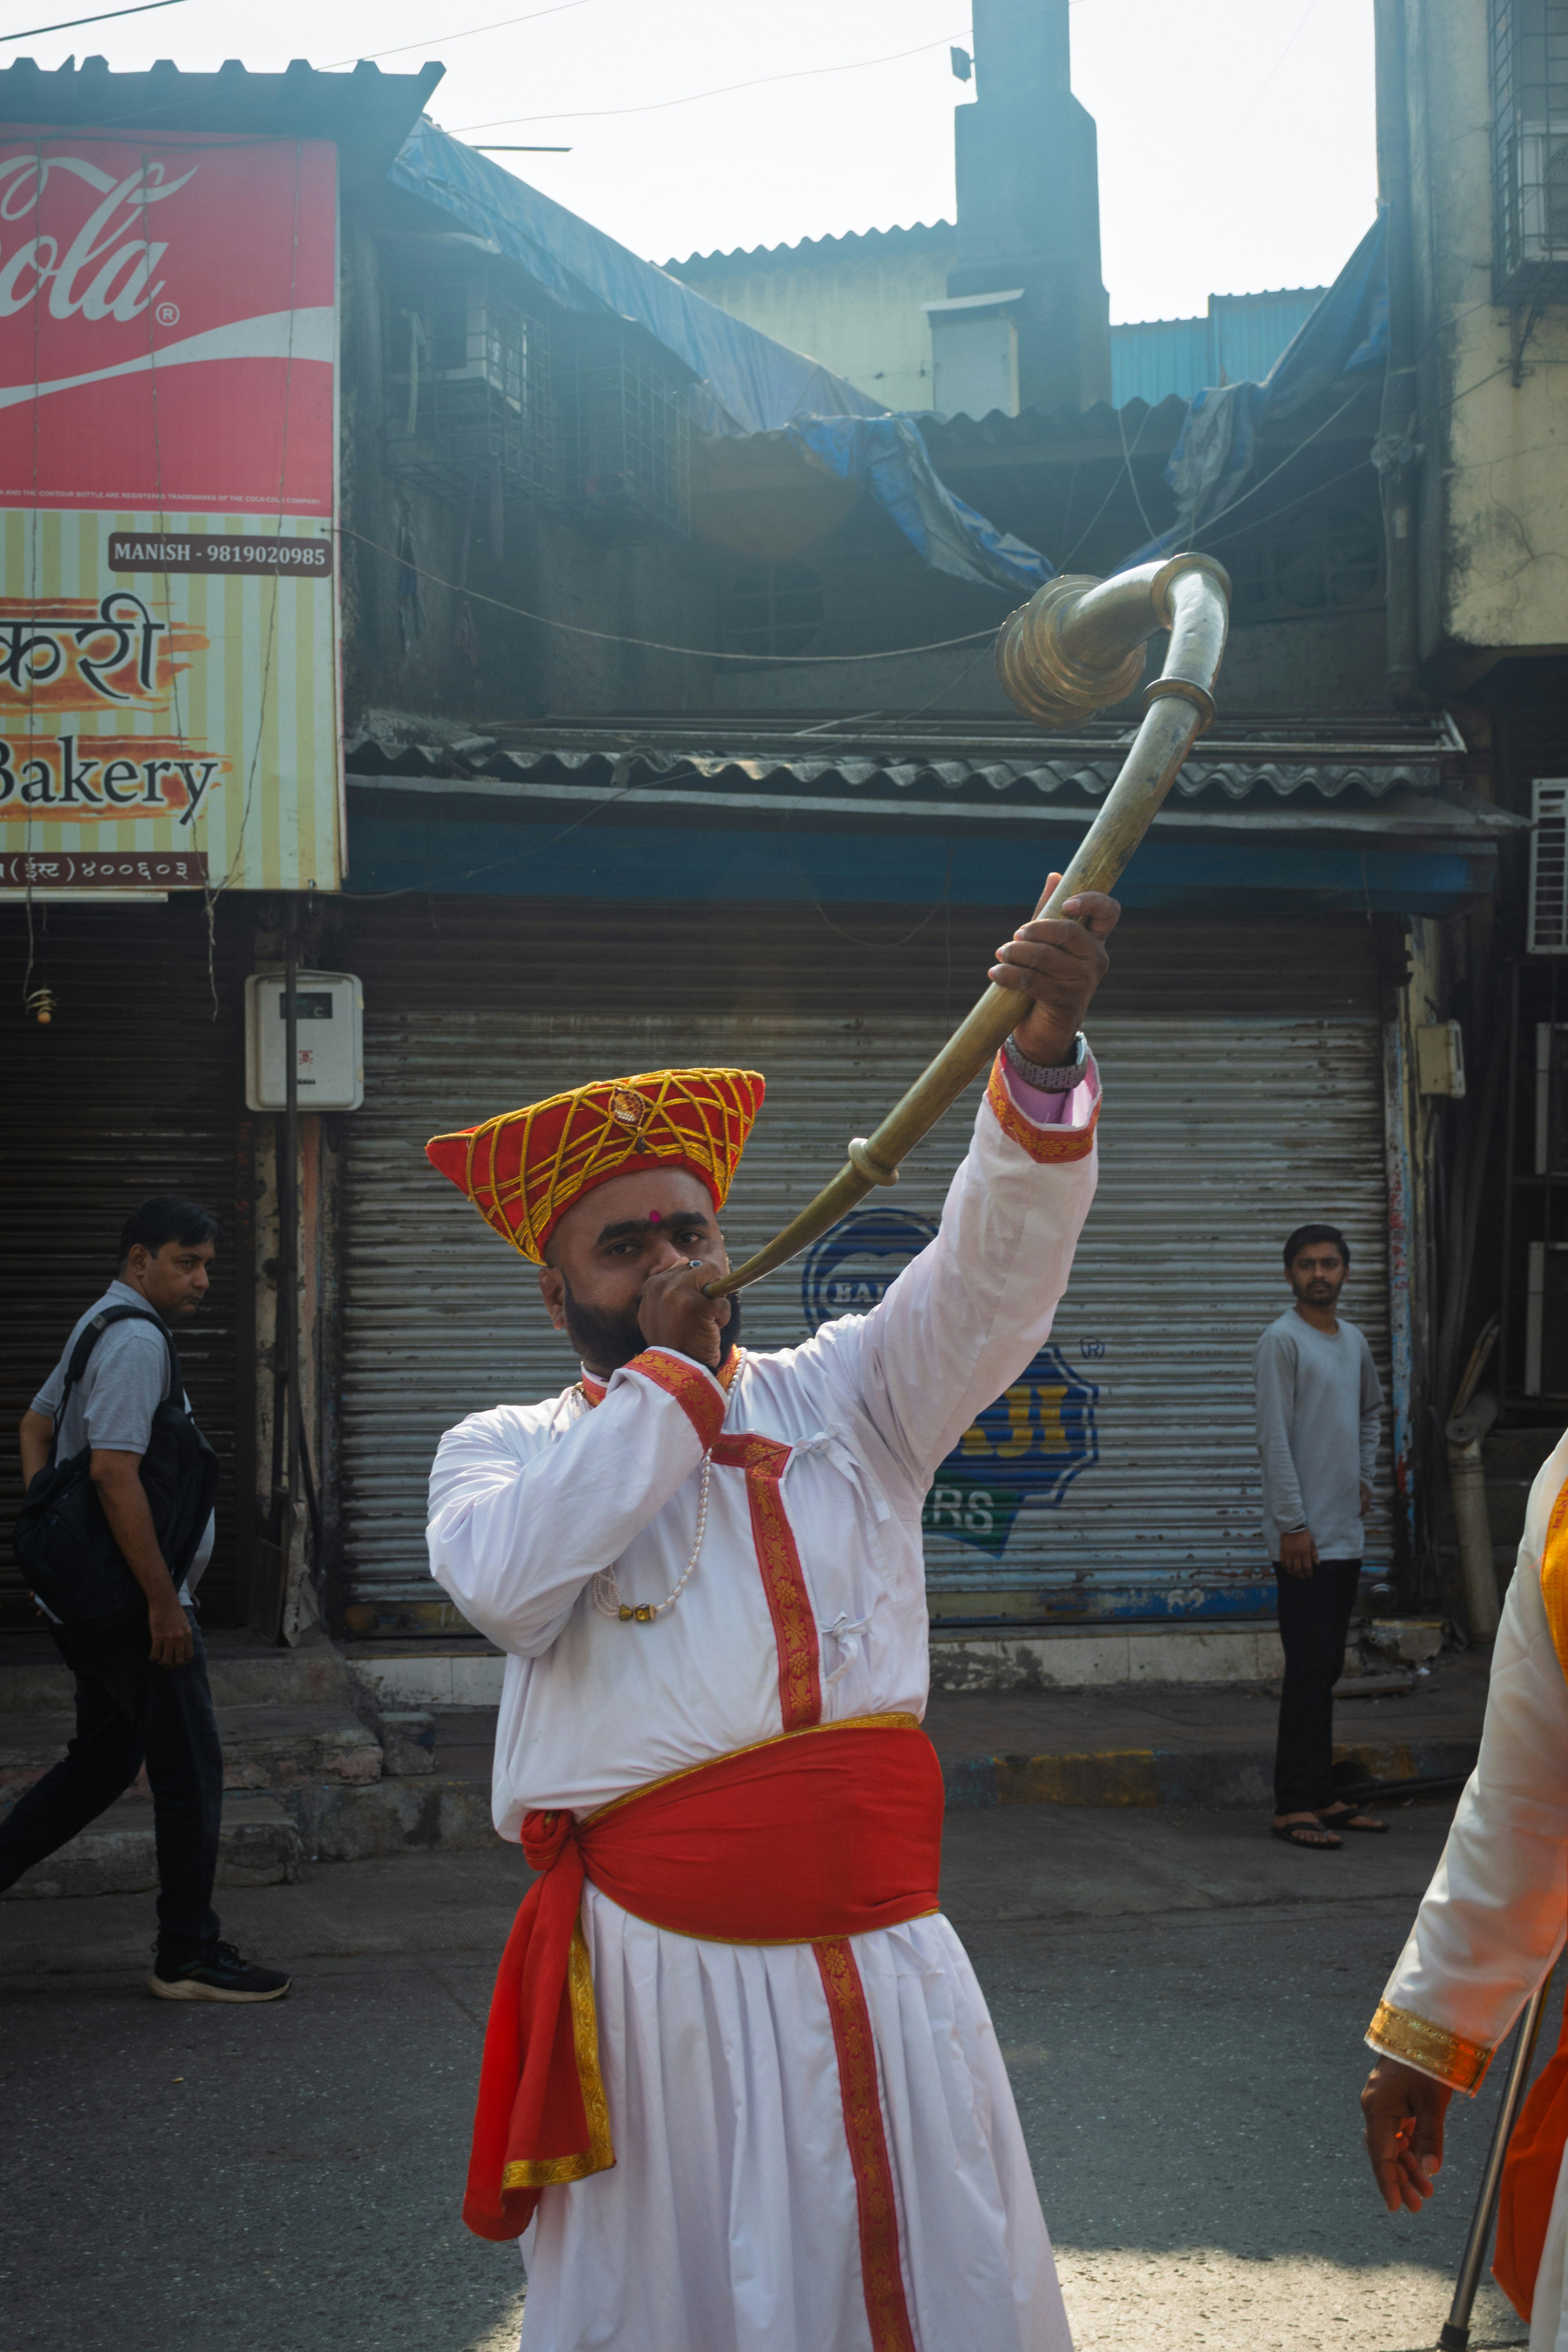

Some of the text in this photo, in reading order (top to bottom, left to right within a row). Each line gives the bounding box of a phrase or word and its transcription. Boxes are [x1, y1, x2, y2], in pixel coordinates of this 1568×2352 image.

[0, 155, 199, 322] ola
[168, 493, 216, 501] TRADEMARKS
[114, 543, 191, 561] MANISH
[207, 545, 326, 566] 9819020985
